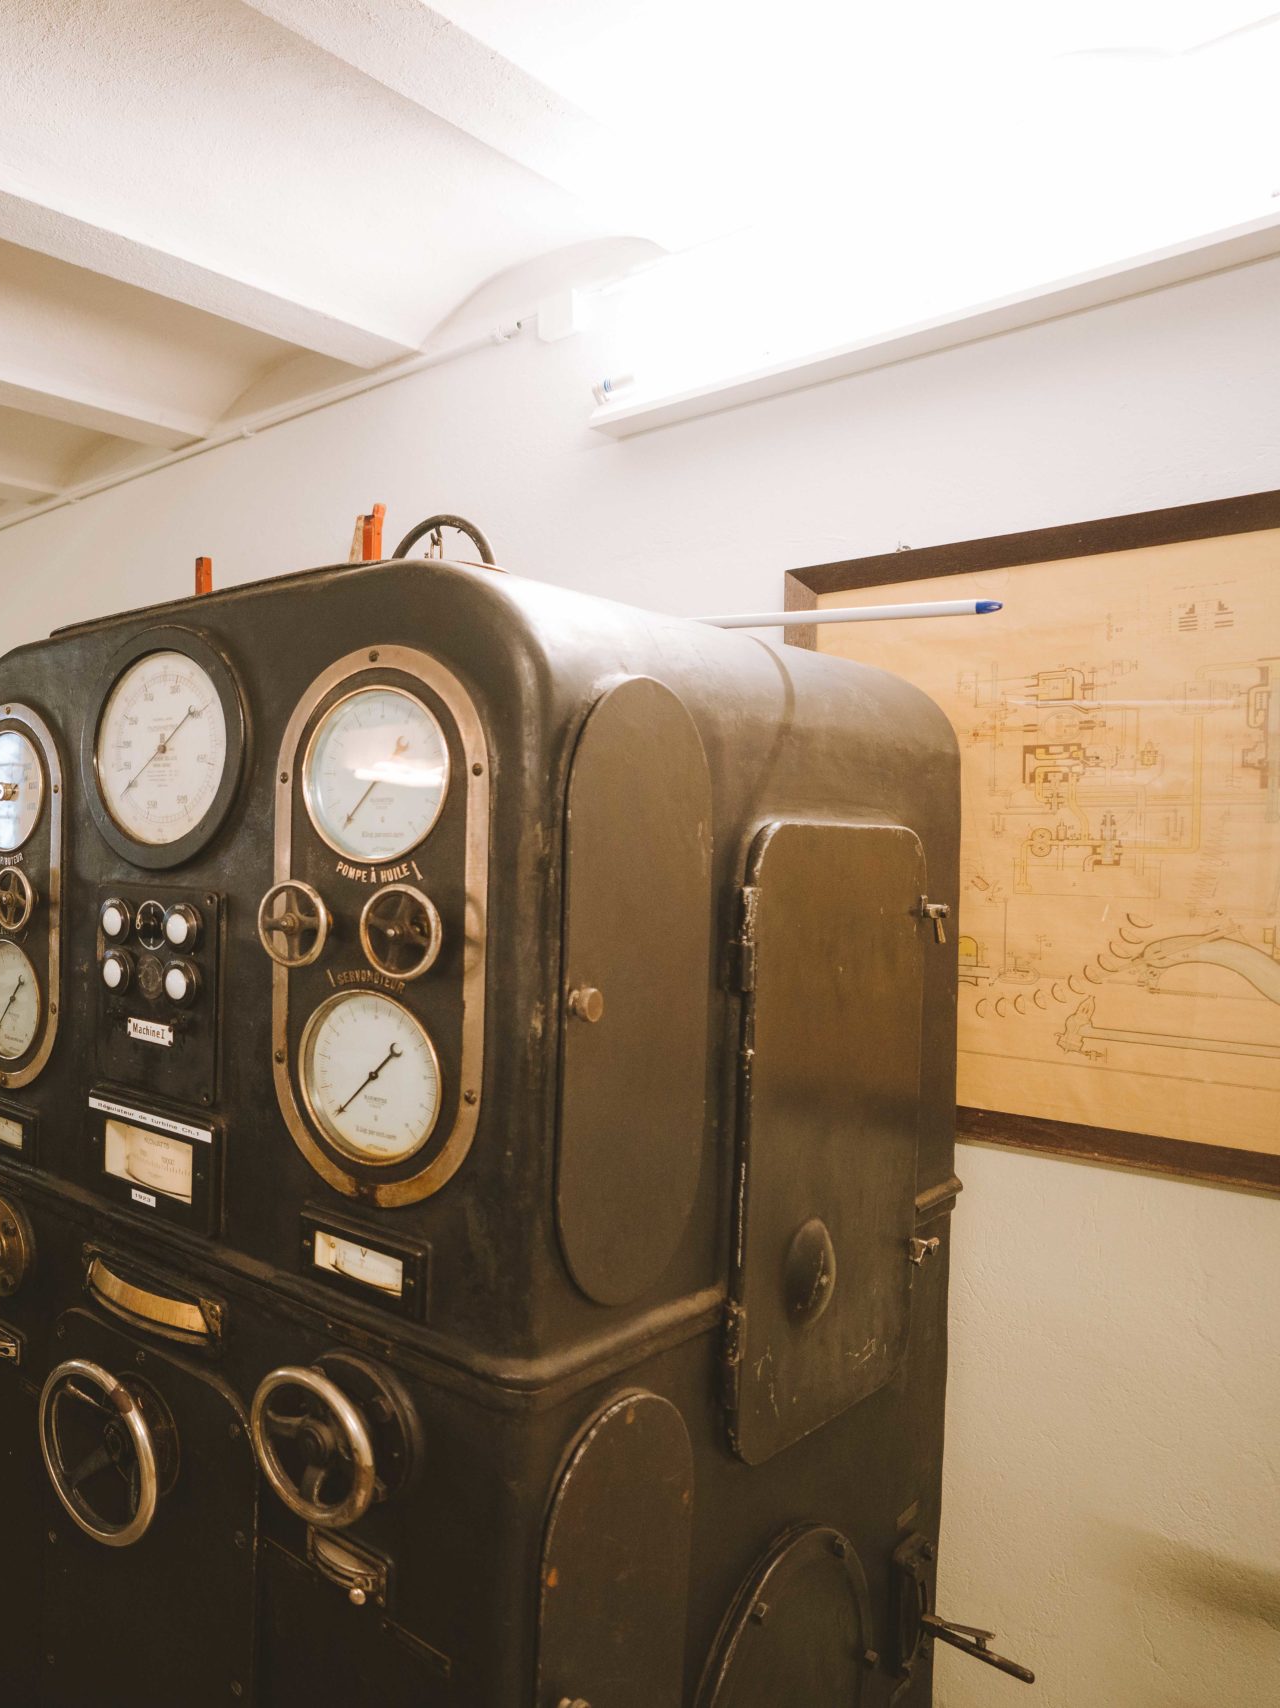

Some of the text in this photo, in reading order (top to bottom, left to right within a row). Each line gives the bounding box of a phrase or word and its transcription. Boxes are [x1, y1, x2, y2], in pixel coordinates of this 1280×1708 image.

[336, 861, 368, 883] POMPE
[380, 863, 410, 883] HUILE
[337, 969, 405, 993] SERVOMOTEUR
[151, 1118, 178, 1131] turbine
